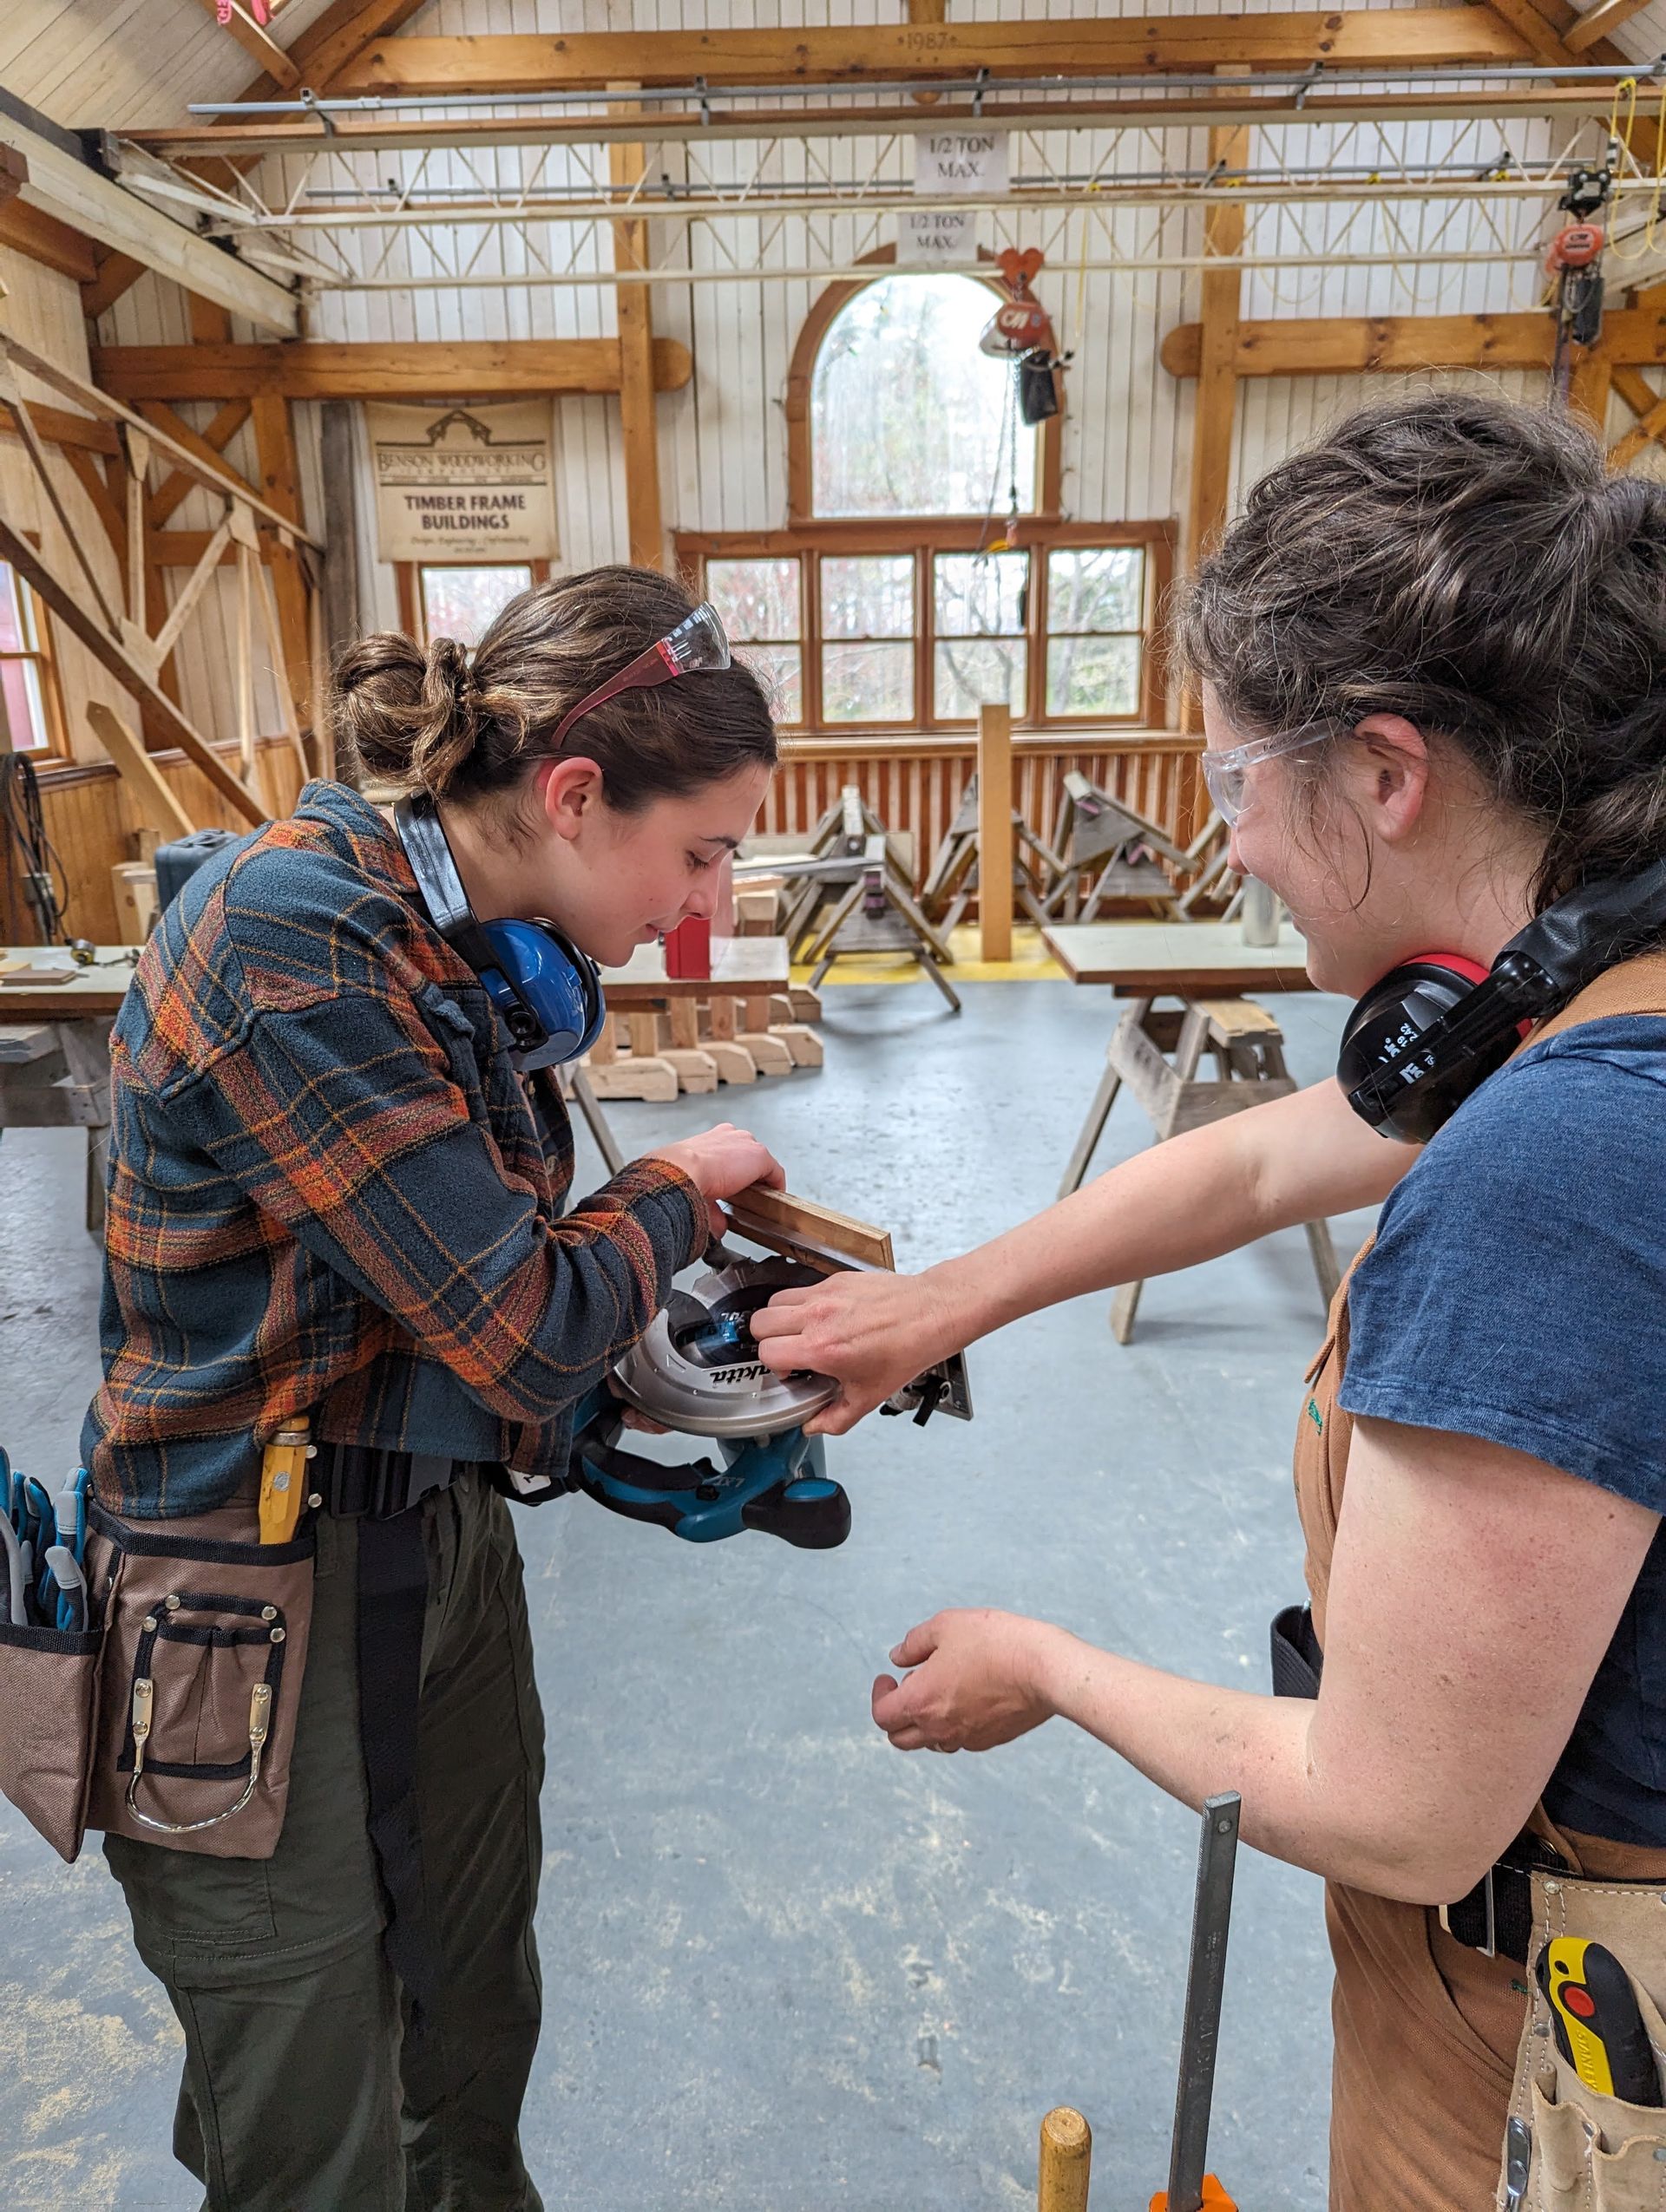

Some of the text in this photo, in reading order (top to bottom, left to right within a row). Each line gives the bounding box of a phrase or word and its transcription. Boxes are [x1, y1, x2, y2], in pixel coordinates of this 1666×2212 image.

[930, 135, 995, 154] 1/2 TON
[911, 214, 965, 229] 1/2 TON
[404, 494, 526, 511] TIMBER FRAME
[422, 514, 509, 529] BUILDINGS
[1400, 1023, 1419, 1042] 2.42
[1397, 1036, 1407, 1048] 19
[710, 1364, 771, 1385] akita
